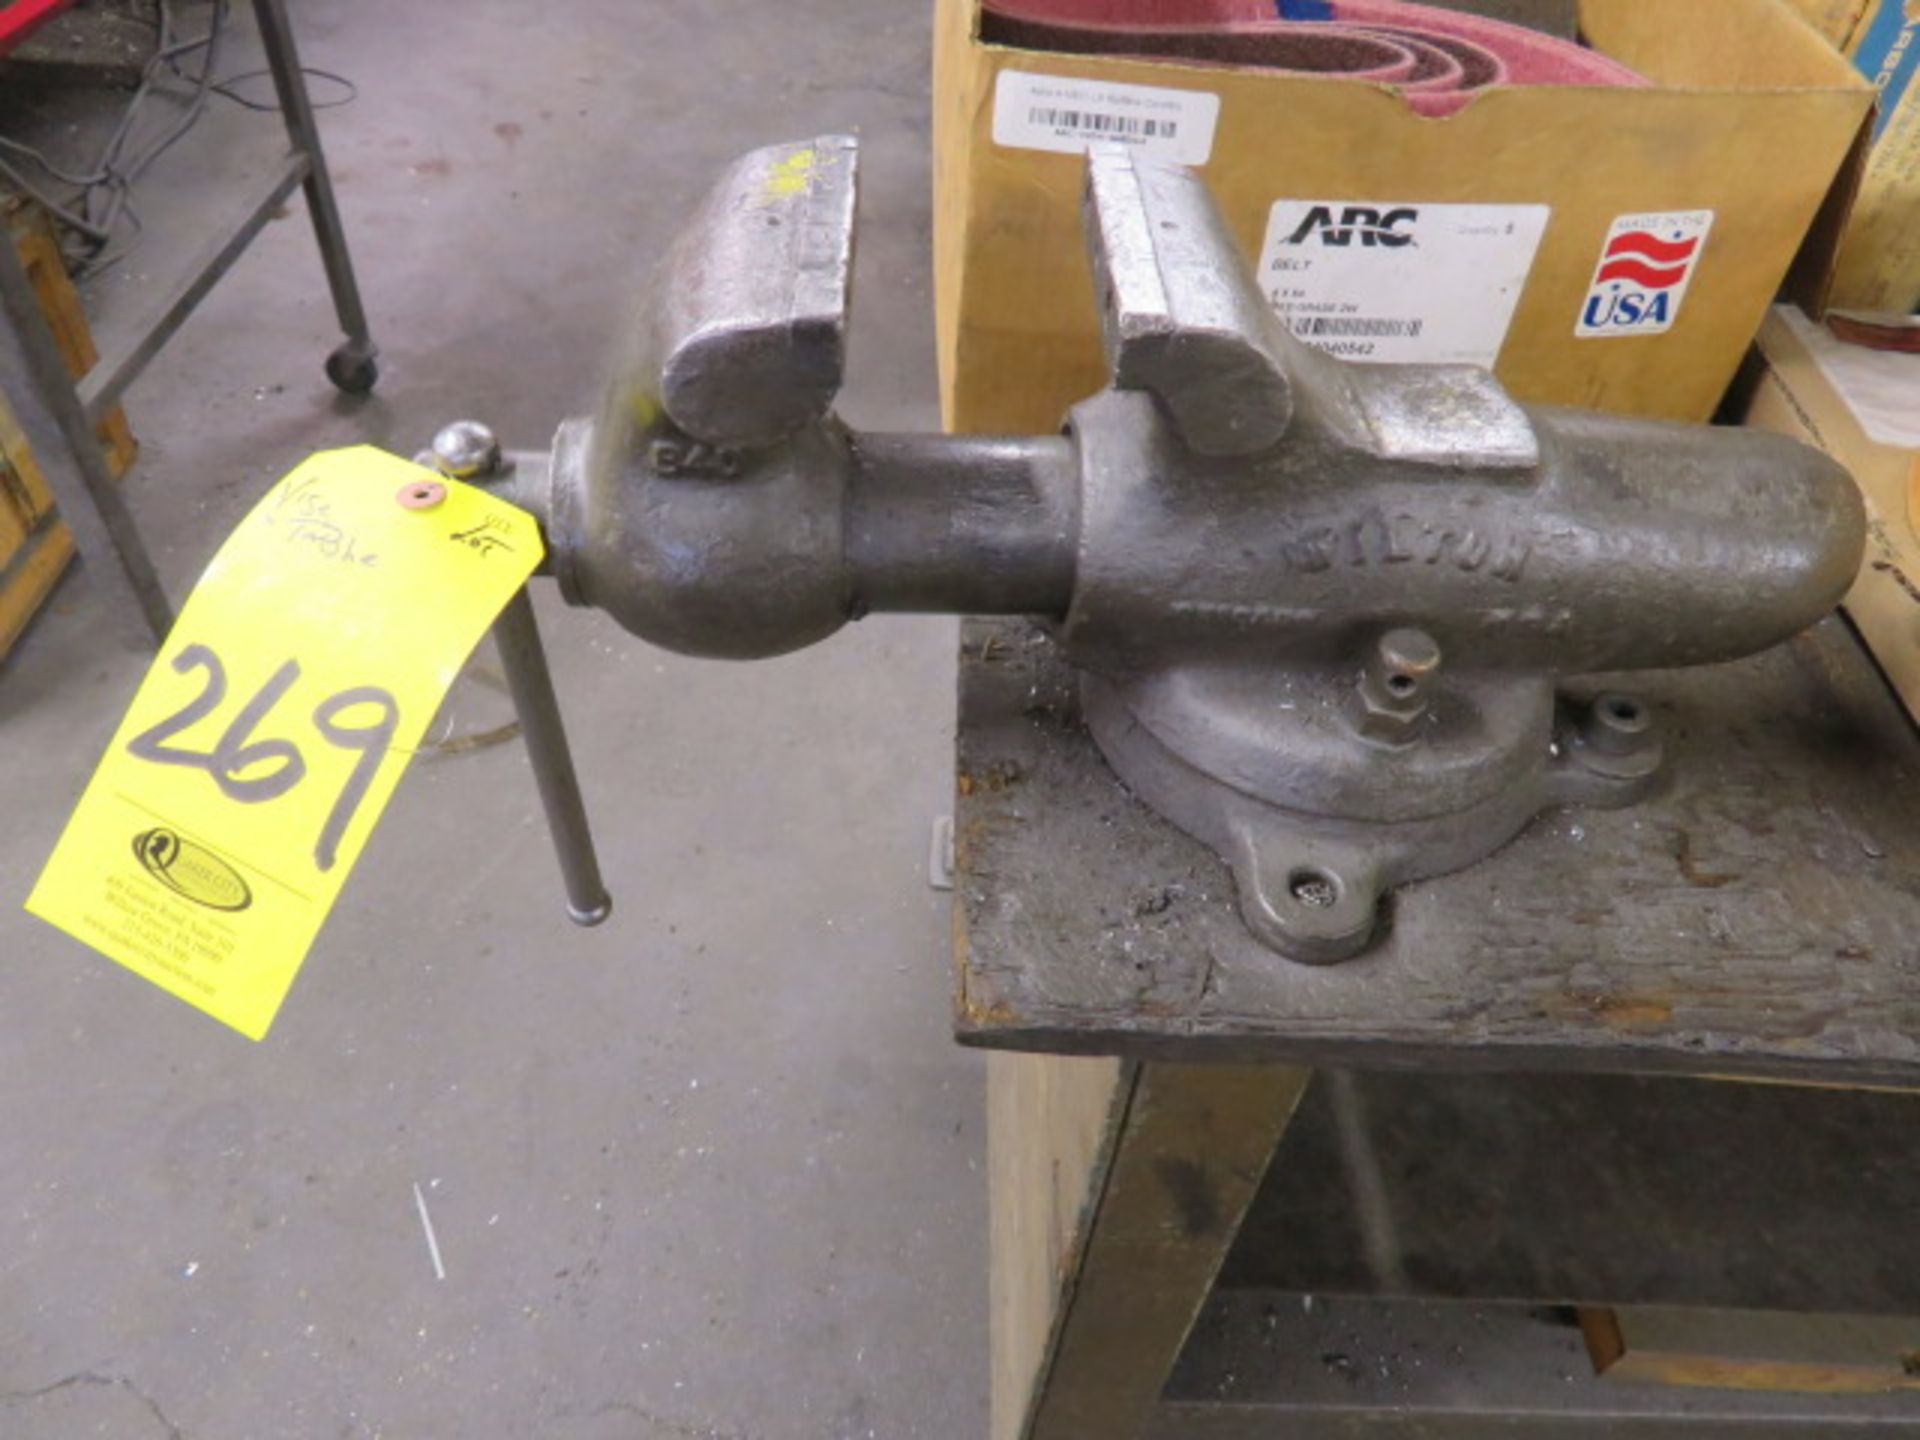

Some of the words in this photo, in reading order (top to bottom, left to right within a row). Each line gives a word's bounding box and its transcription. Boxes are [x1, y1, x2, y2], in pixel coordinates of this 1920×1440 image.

[1278, 205, 1418, 248] ARC
[1271, 258, 1312, 271] BELT
[1583, 291, 1669, 327] USA
[126, 642, 400, 873] 269
